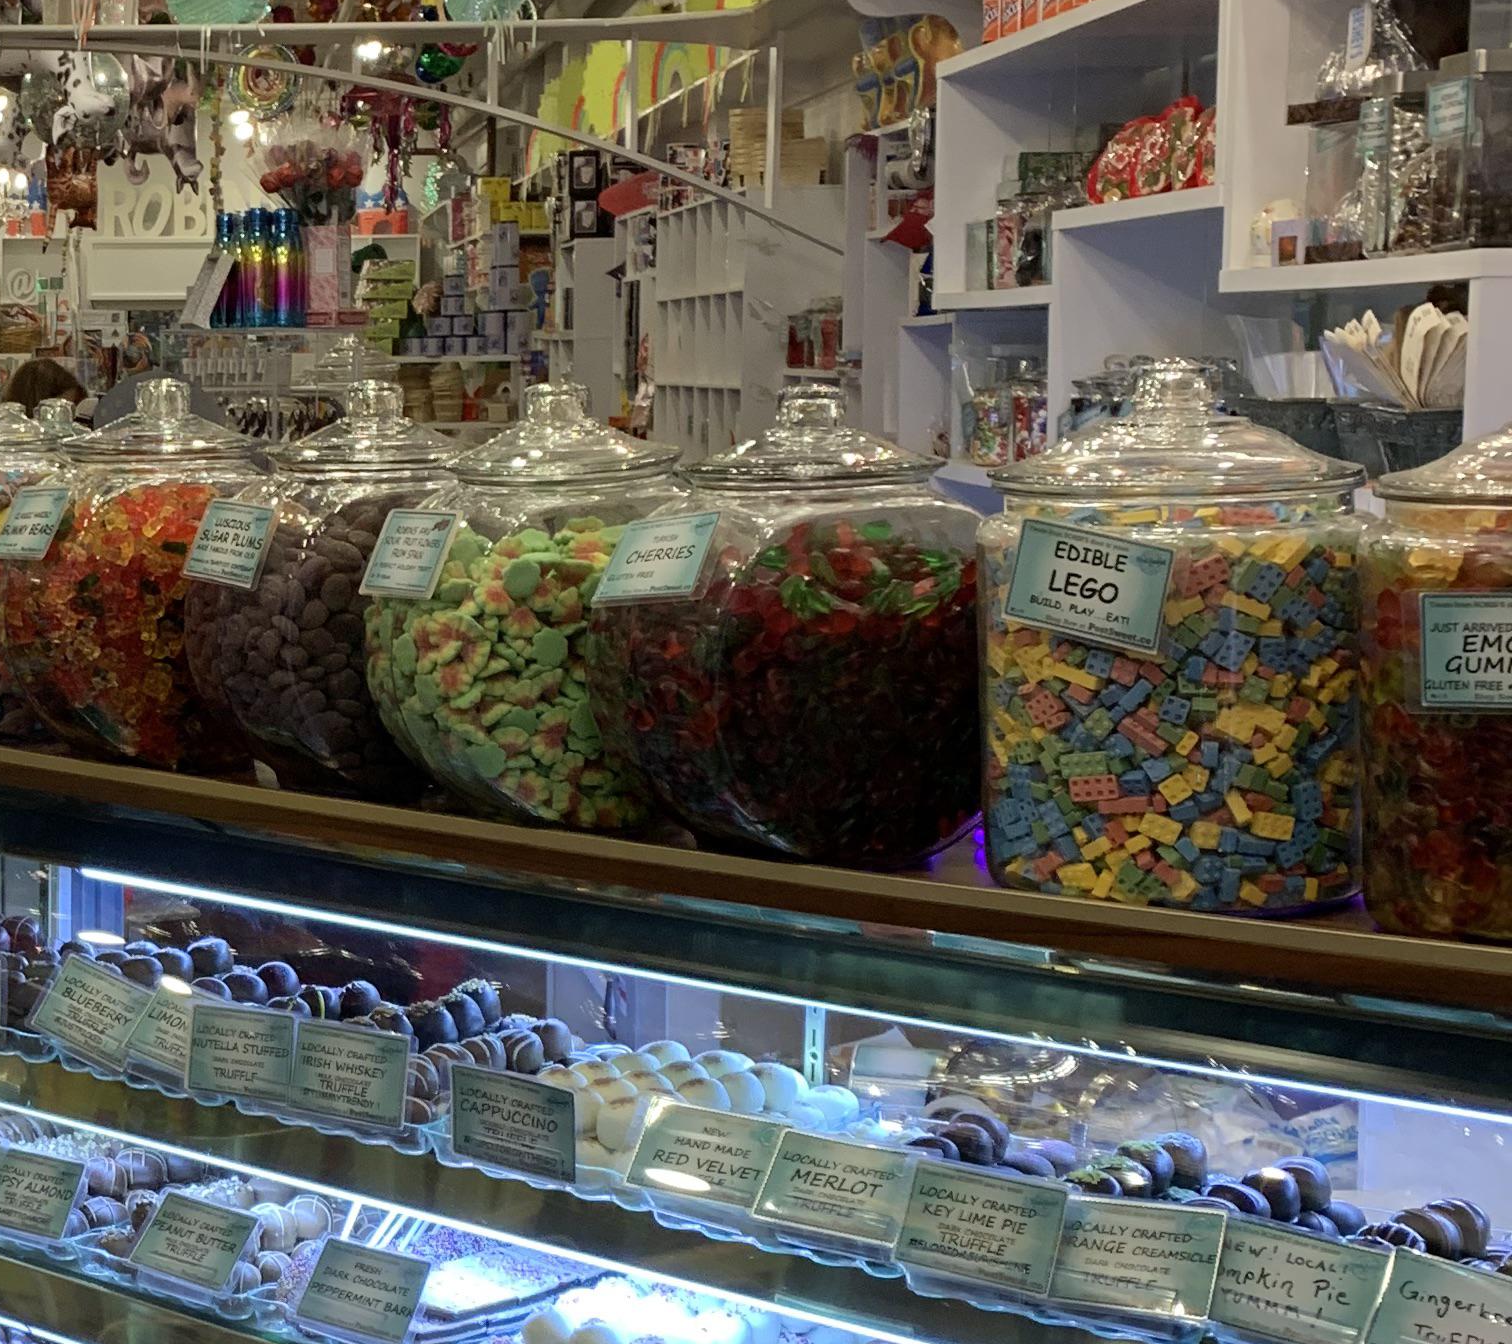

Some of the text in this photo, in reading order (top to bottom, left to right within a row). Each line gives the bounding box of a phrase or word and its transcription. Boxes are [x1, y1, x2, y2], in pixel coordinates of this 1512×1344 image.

[200, 530, 264, 550] SUGAR PLUMS
[625, 545, 695, 565] CHERRIES
[1054, 540, 1129, 573] EDIBLE
[1048, 569, 1119, 604] LEGO
[1430, 622, 1458, 632] JUST
[1424, 679, 1503, 691] GLUTEN FREE
[62, 986, 134, 1026] BLUEBERRY
[197, 1023, 235, 1038] LOCALLY
[192, 1037, 290, 1058] NUTELLA STUFFED
[301, 1041, 389, 1065] LOCALLY CRAFTED
[302, 1056, 387, 1079] IRISH WHISKEY
[319, 1079, 368, 1098] TRUFFLE
[460, 1087, 508, 1106] LOCALLY
[460, 1098, 559, 1133] CAPPUCCINO
[702, 1125, 730, 1140] NEW
[674, 1136, 752, 1160] HAND MADE
[652, 1149, 690, 1170] RED
[696, 1156, 764, 1183] VELVET
[782, 1149, 895, 1182] LOCALLY CRAFTED
[24, 1177, 74, 1202] ALMOND
[789, 1168, 884, 1199] MERLOT
[919, 1184, 1038, 1220] LOCALLY CRAFTED
[922, 1203, 1029, 1236] KEY LIME PIE
[151, 1220, 237, 1254] PEANUT BUTTER
[940, 1231, 1007, 1257] TRUFFLE
[1132, 1226, 1193, 1244] CRAFTED
[1131, 1244, 1217, 1265] CREAMSICLE
[353, 1261, 382, 1277] FRESH
[323, 1266, 410, 1298] DARK CHOCOLATE
[1312, 1277, 1352, 1307] Pie
[311, 1280, 414, 1318] PEPPERMINT BARK
